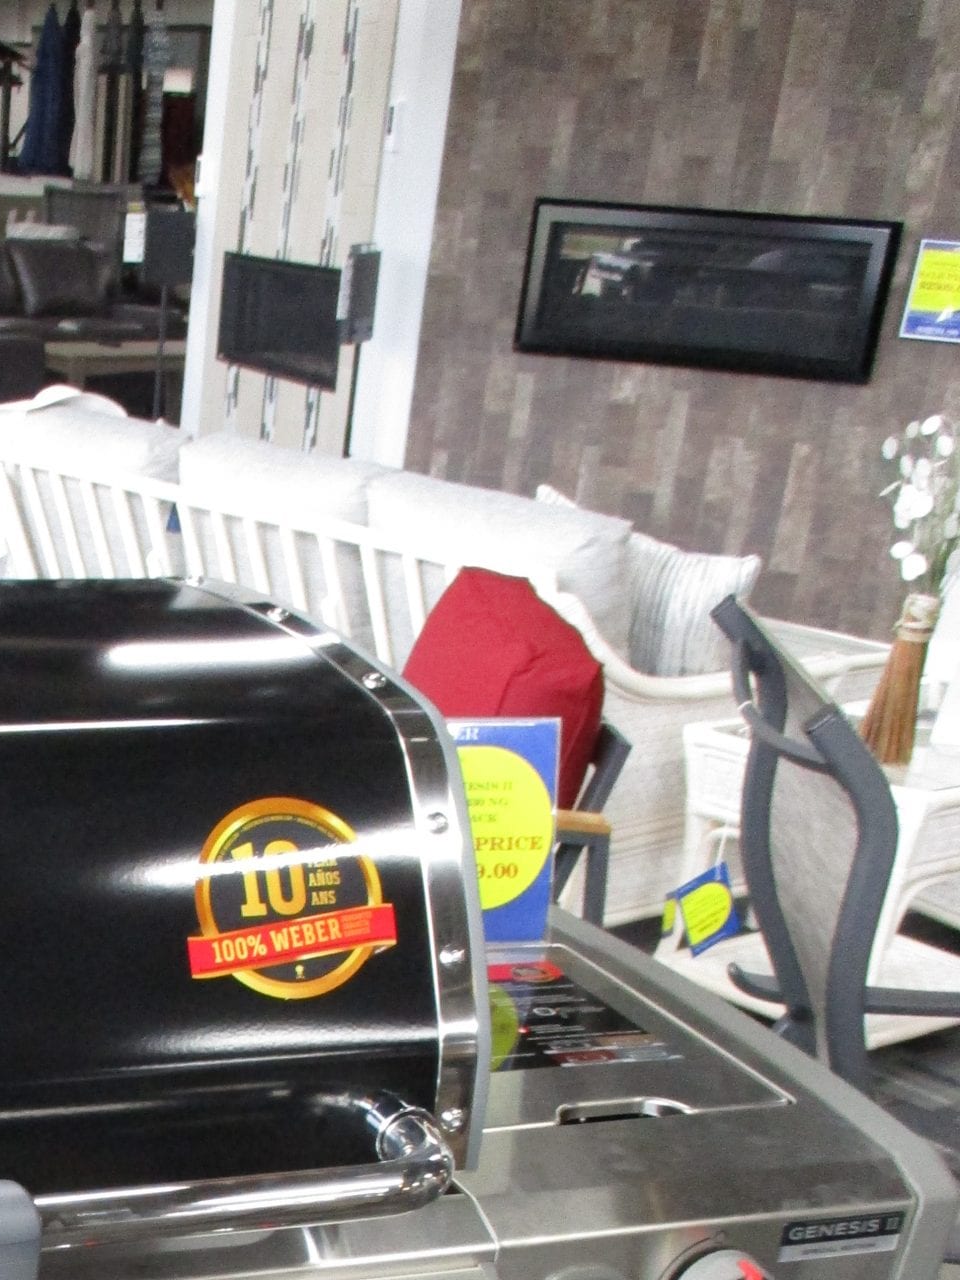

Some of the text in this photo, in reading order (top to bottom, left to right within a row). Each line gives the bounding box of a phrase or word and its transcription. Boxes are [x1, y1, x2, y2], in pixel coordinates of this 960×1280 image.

[475, 836, 543, 851] PRICE
[231, 840, 306, 917] 10
[309, 870, 340, 886] AÑOS
[311, 891, 336, 905] ANS
[212, 934, 268, 964] 100%
[269, 918, 342, 952] WEBER
[789, 1219, 880, 1240] GENESIS
